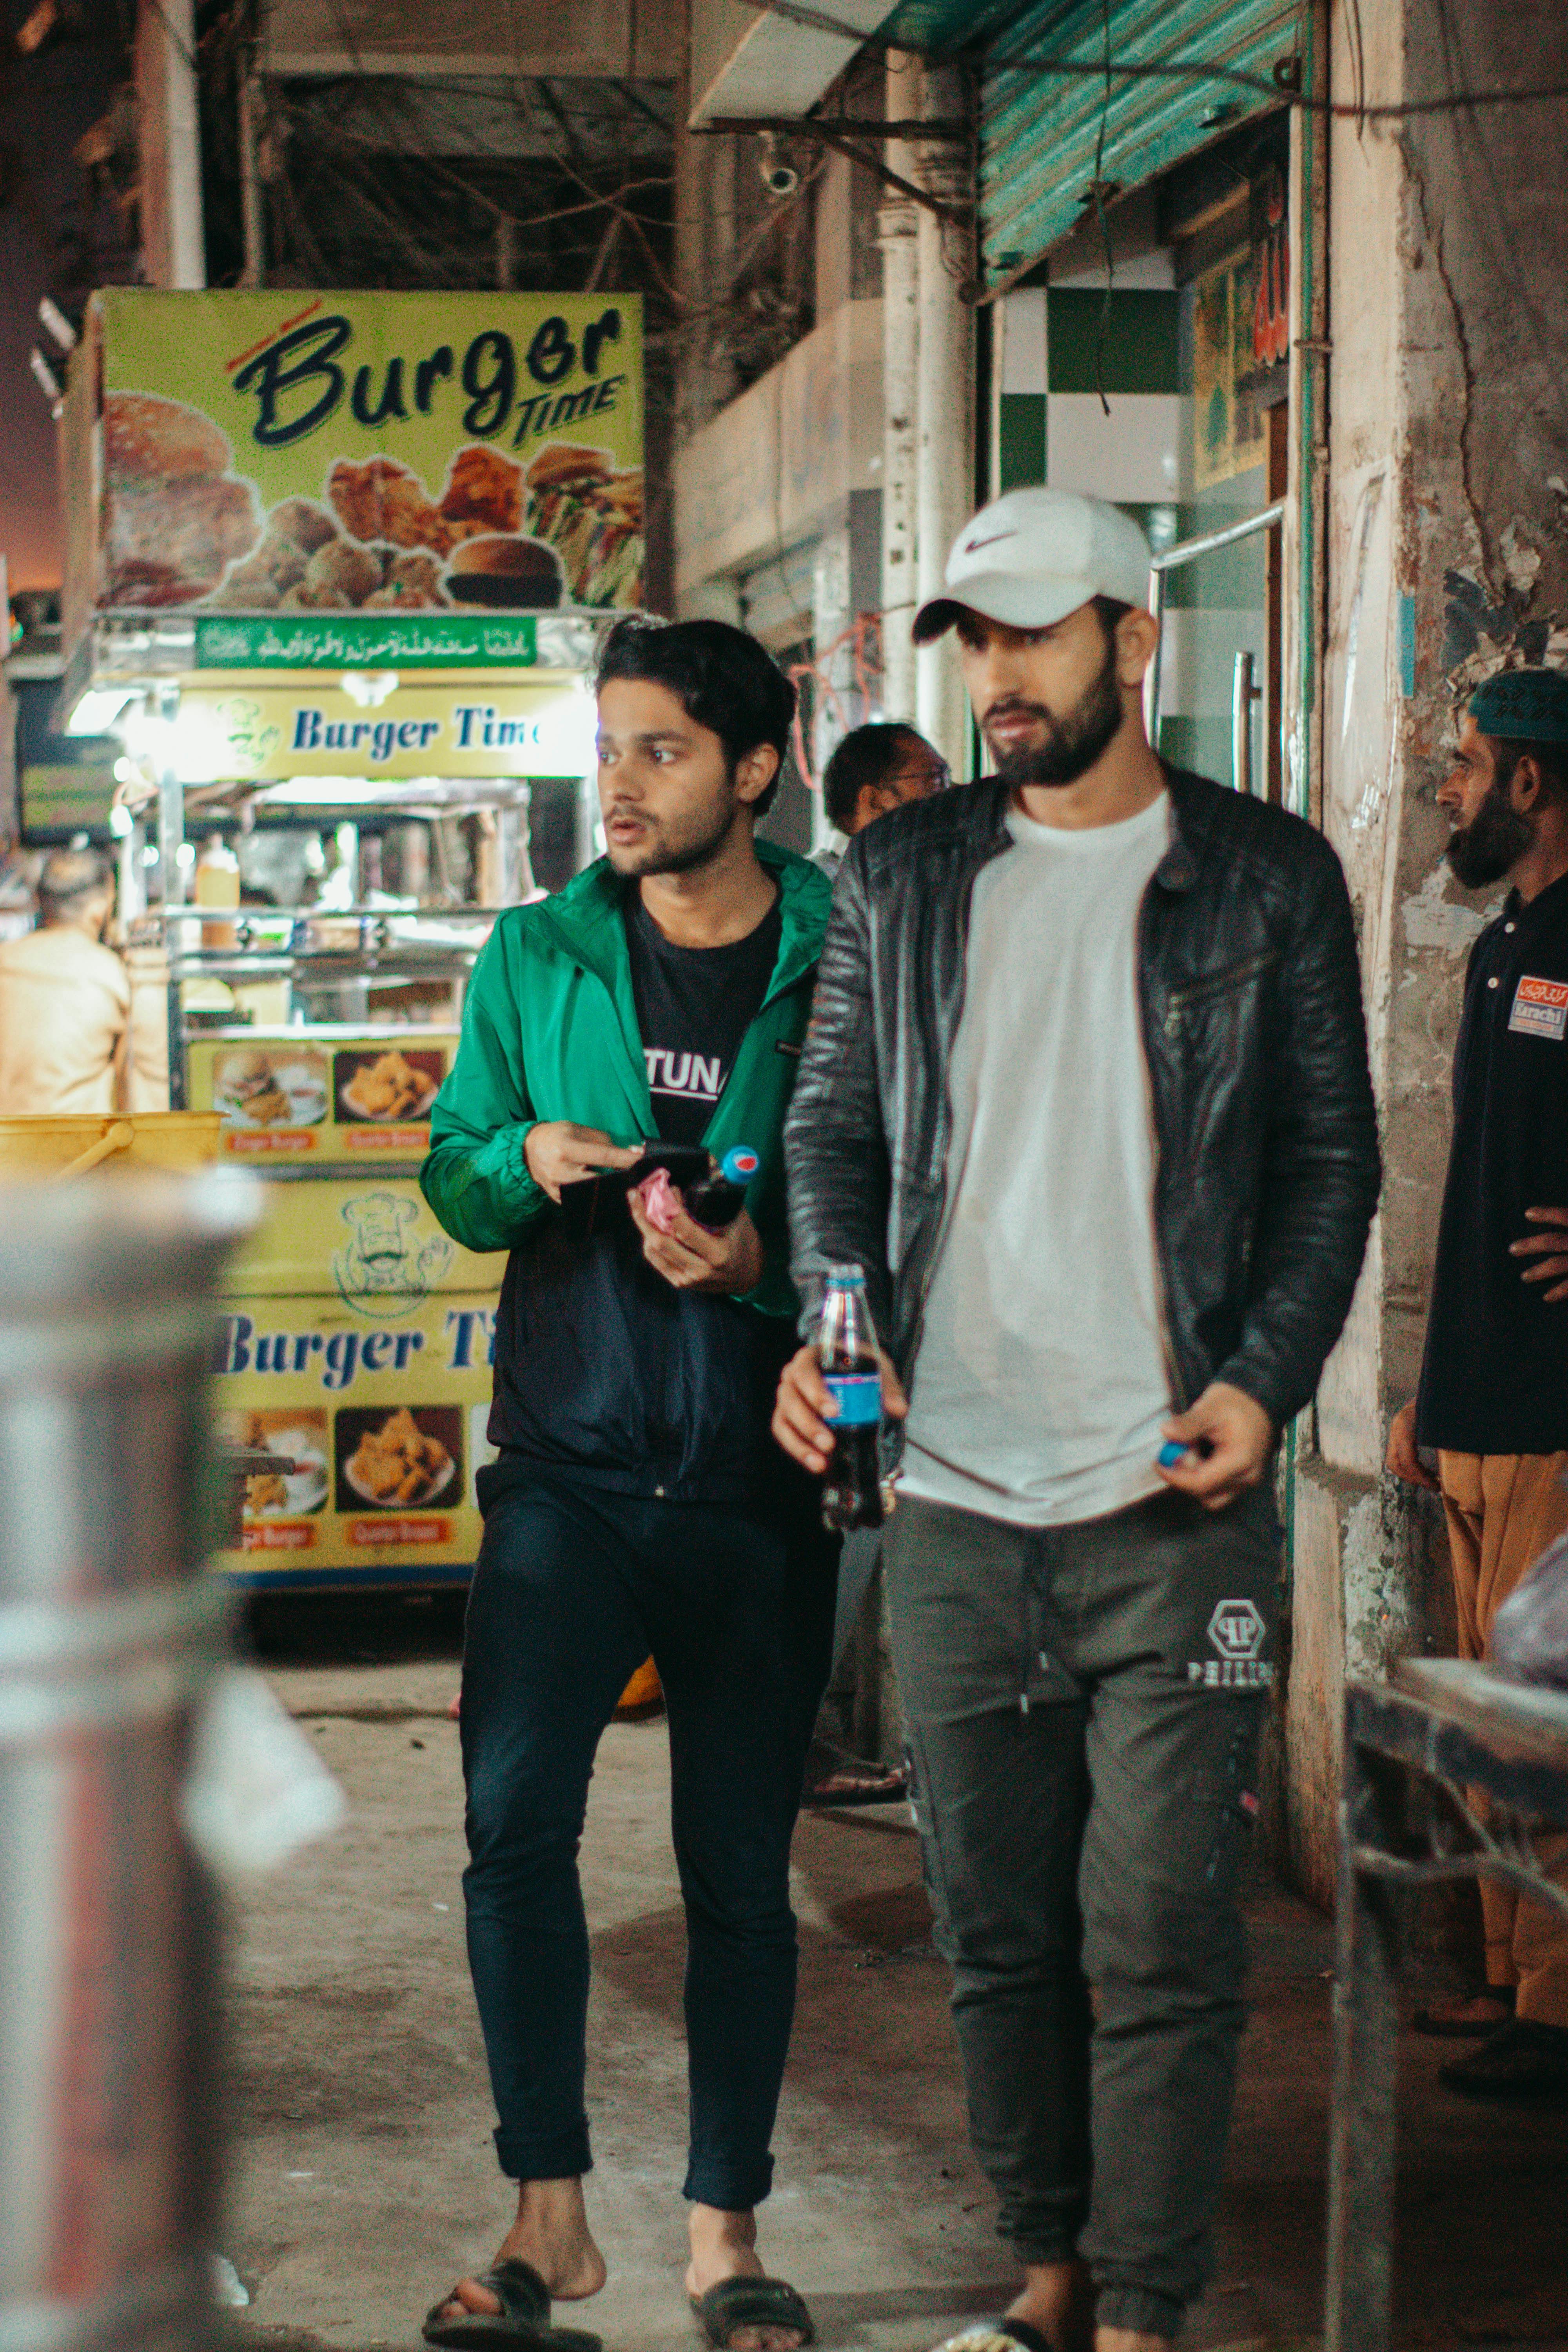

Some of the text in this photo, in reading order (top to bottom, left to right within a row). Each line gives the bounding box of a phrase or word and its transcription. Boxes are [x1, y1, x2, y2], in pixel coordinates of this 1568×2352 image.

[233, 309, 621, 445] Burger
[292, 710, 439, 760] Burger
[642, 1048, 728, 1093] TUN
[214, 1314, 424, 1389] Burger
